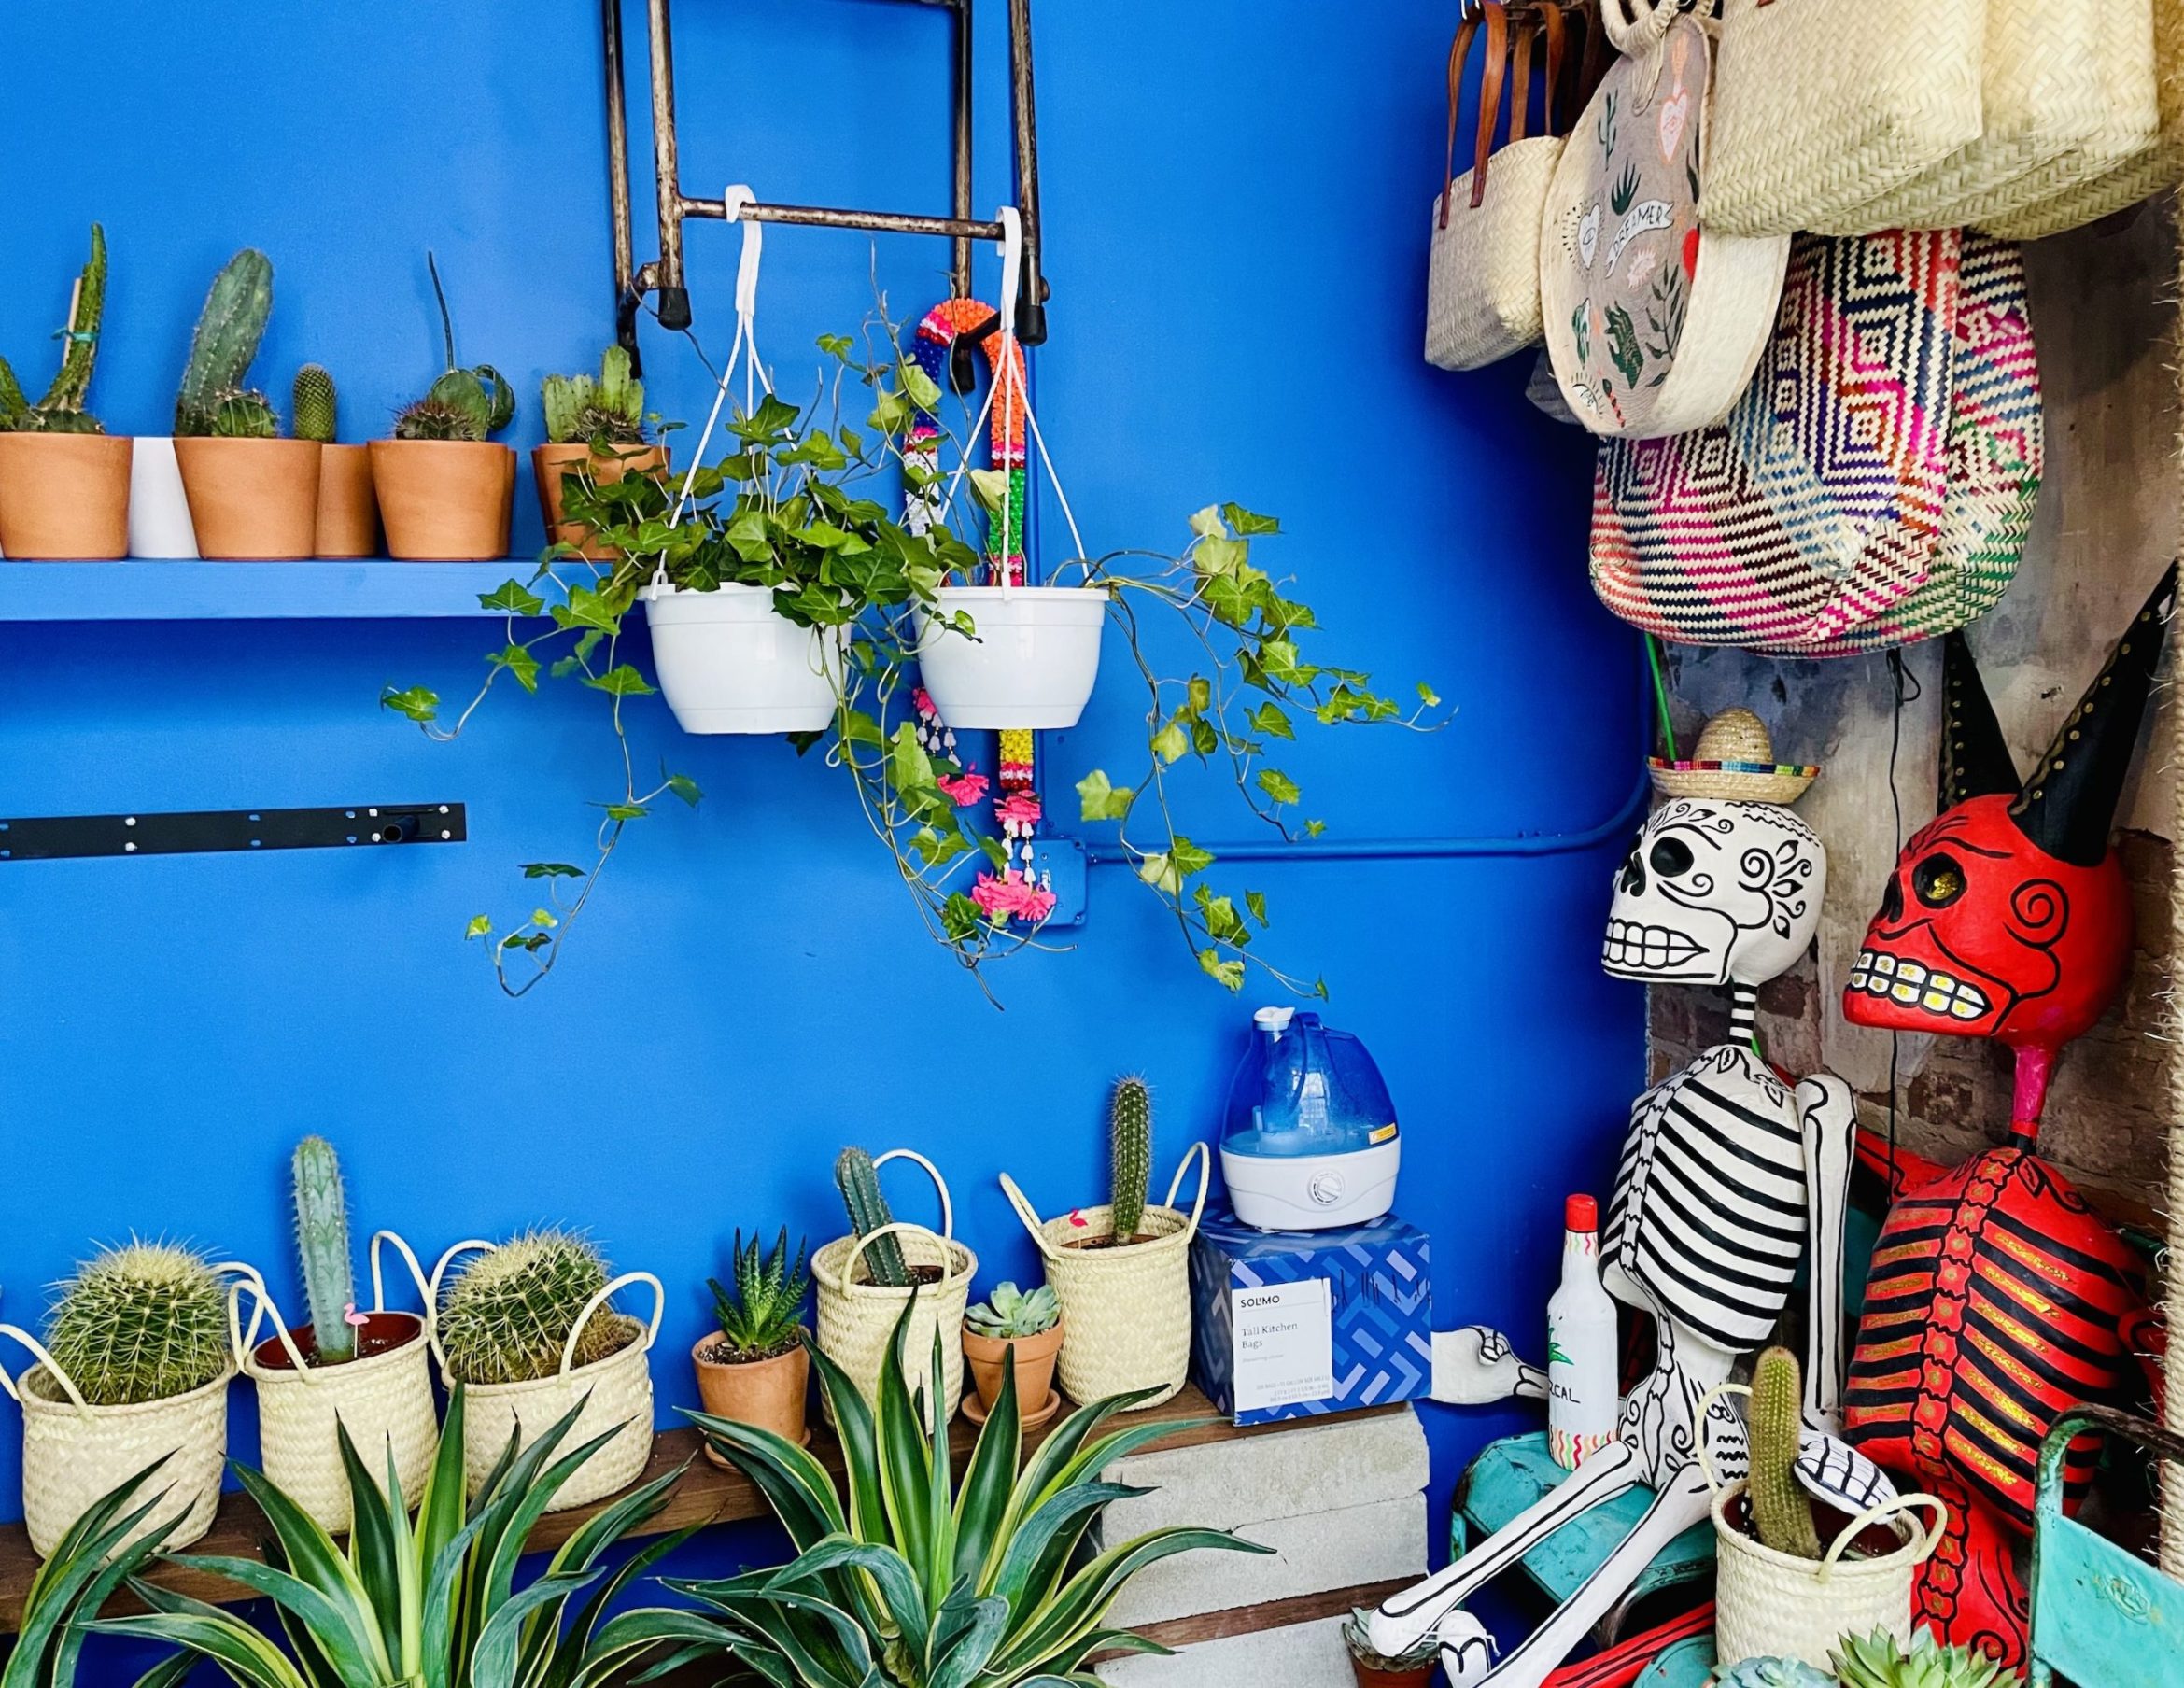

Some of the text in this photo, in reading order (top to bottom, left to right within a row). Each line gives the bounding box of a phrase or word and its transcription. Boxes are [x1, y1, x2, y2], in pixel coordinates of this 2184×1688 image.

[1613, 204, 1662, 257] DREAMER
[1240, 1295, 1280, 1308] SOLIMO
[1242, 1322, 1298, 1337] Tall Kitchen
[1242, 1339, 1263, 1350] Bags
